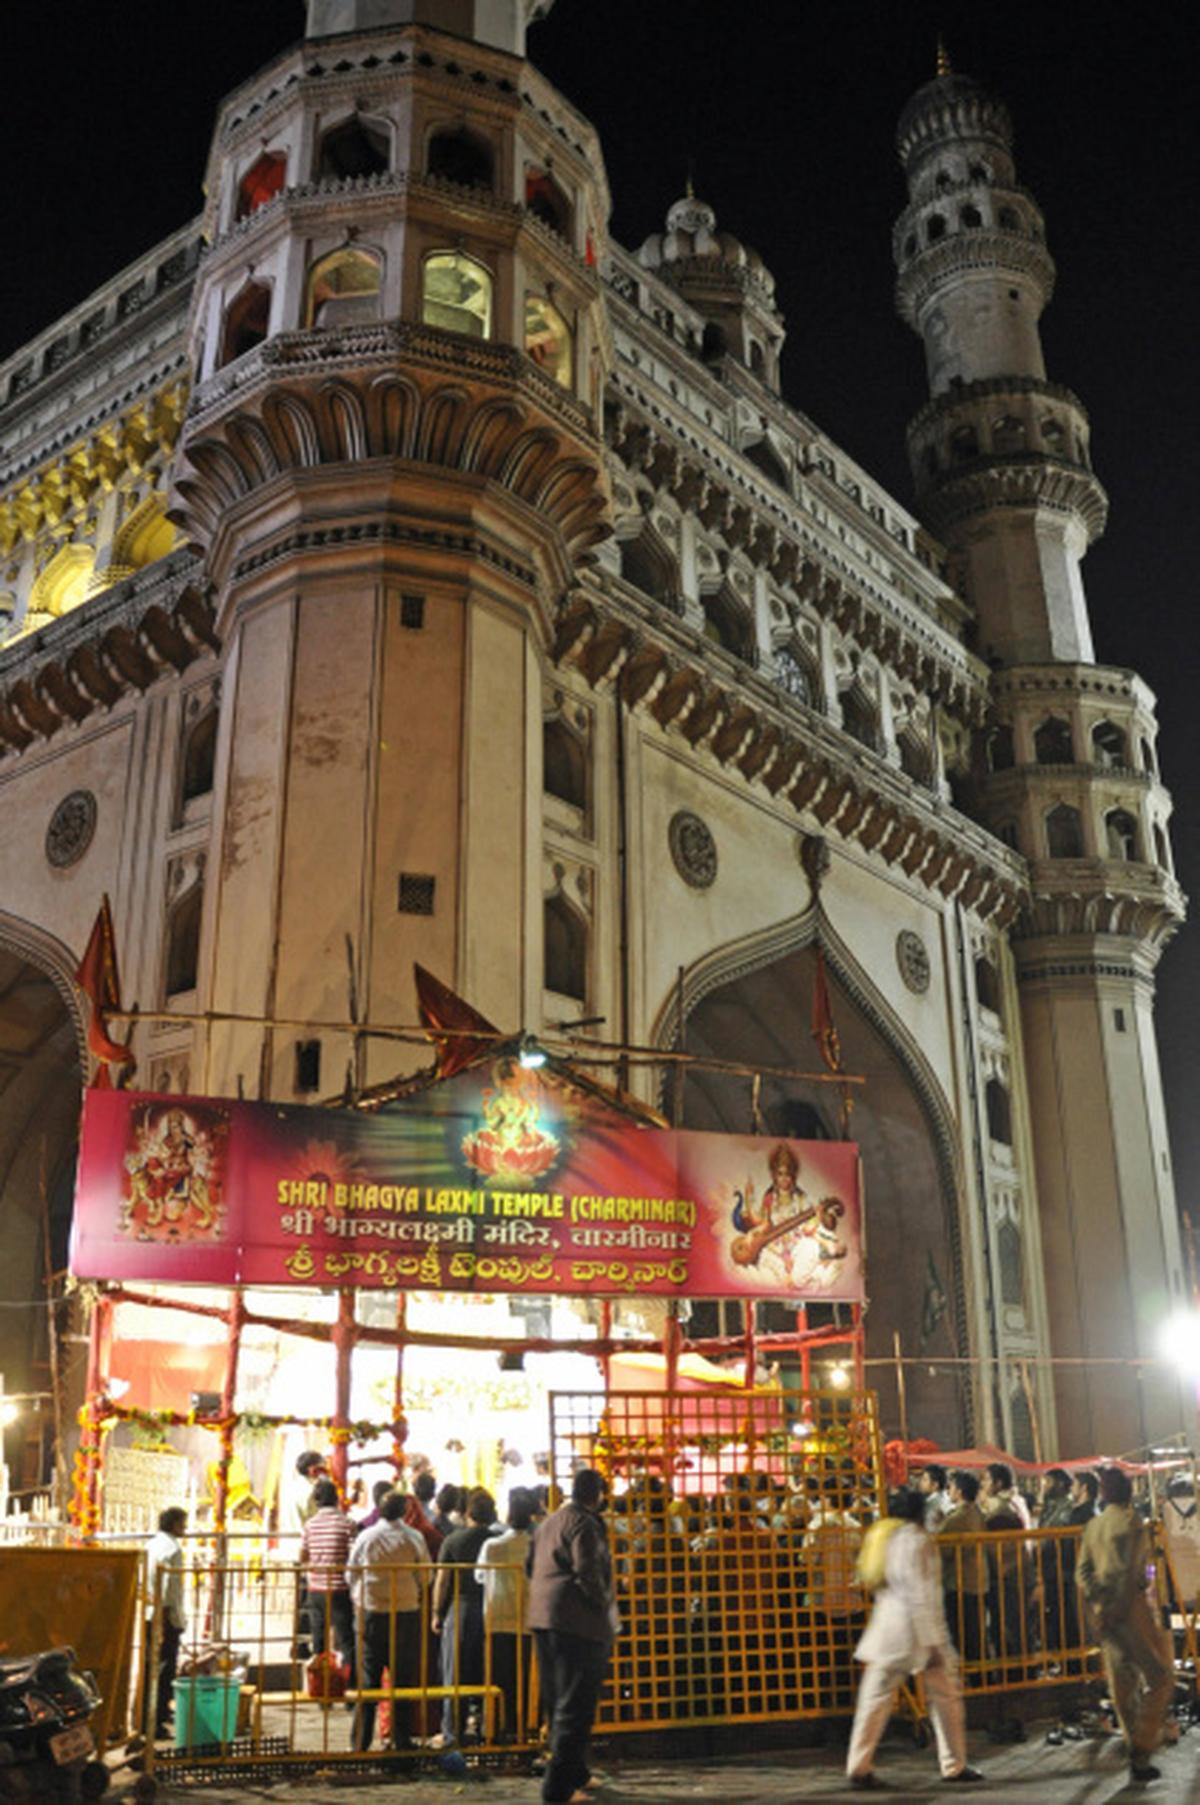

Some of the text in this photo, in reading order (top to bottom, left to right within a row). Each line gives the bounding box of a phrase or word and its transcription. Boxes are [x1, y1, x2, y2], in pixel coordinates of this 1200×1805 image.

[278, 1180, 697, 1228] SHRI BHAGYA LAXMI TEMPLE (CHARMINAR)
[280, 1209, 314, 1236] श्री
